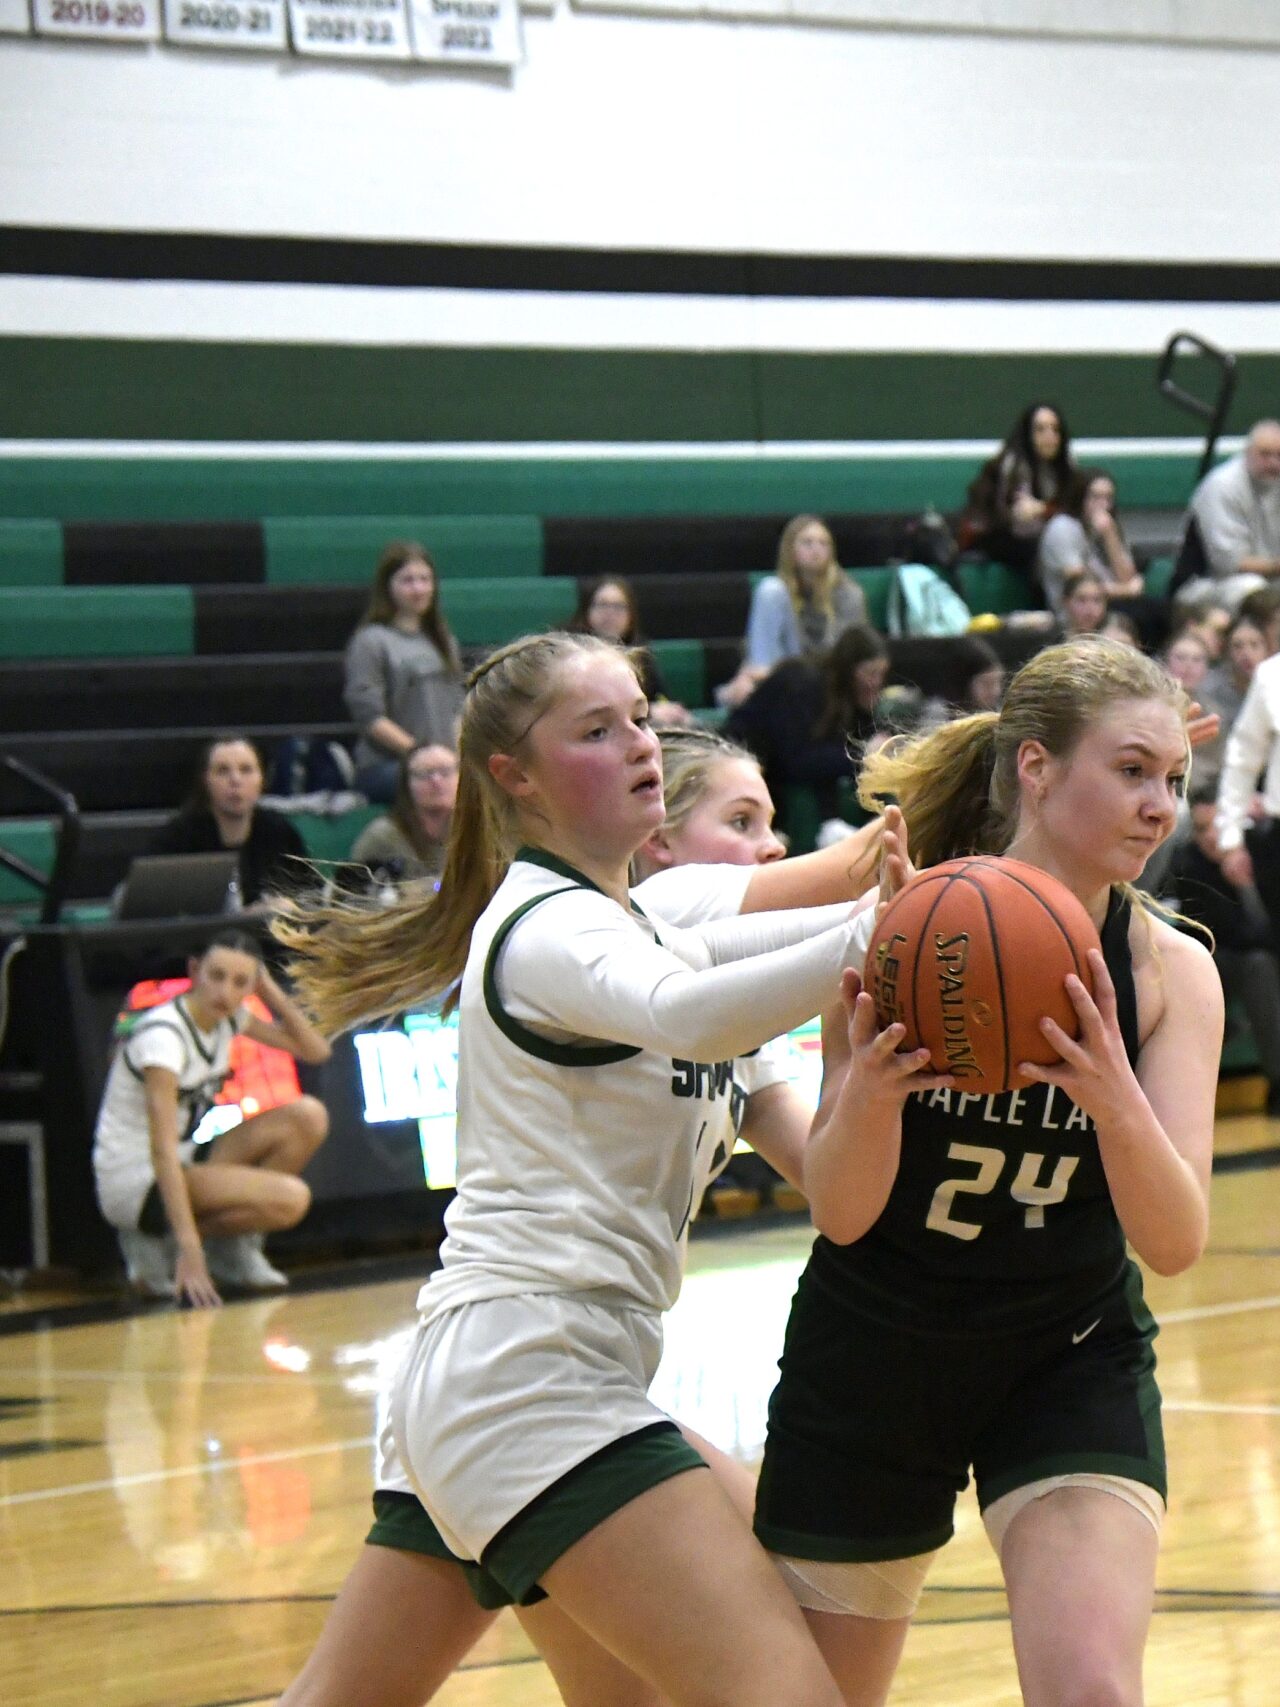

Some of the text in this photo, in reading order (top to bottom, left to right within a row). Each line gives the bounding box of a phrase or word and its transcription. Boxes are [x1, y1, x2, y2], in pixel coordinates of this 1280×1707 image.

[935, 932, 984, 1077] SPALDING
[917, 1084, 1097, 1131] APLE LA
[926, 1142, 1080, 1241] 24
